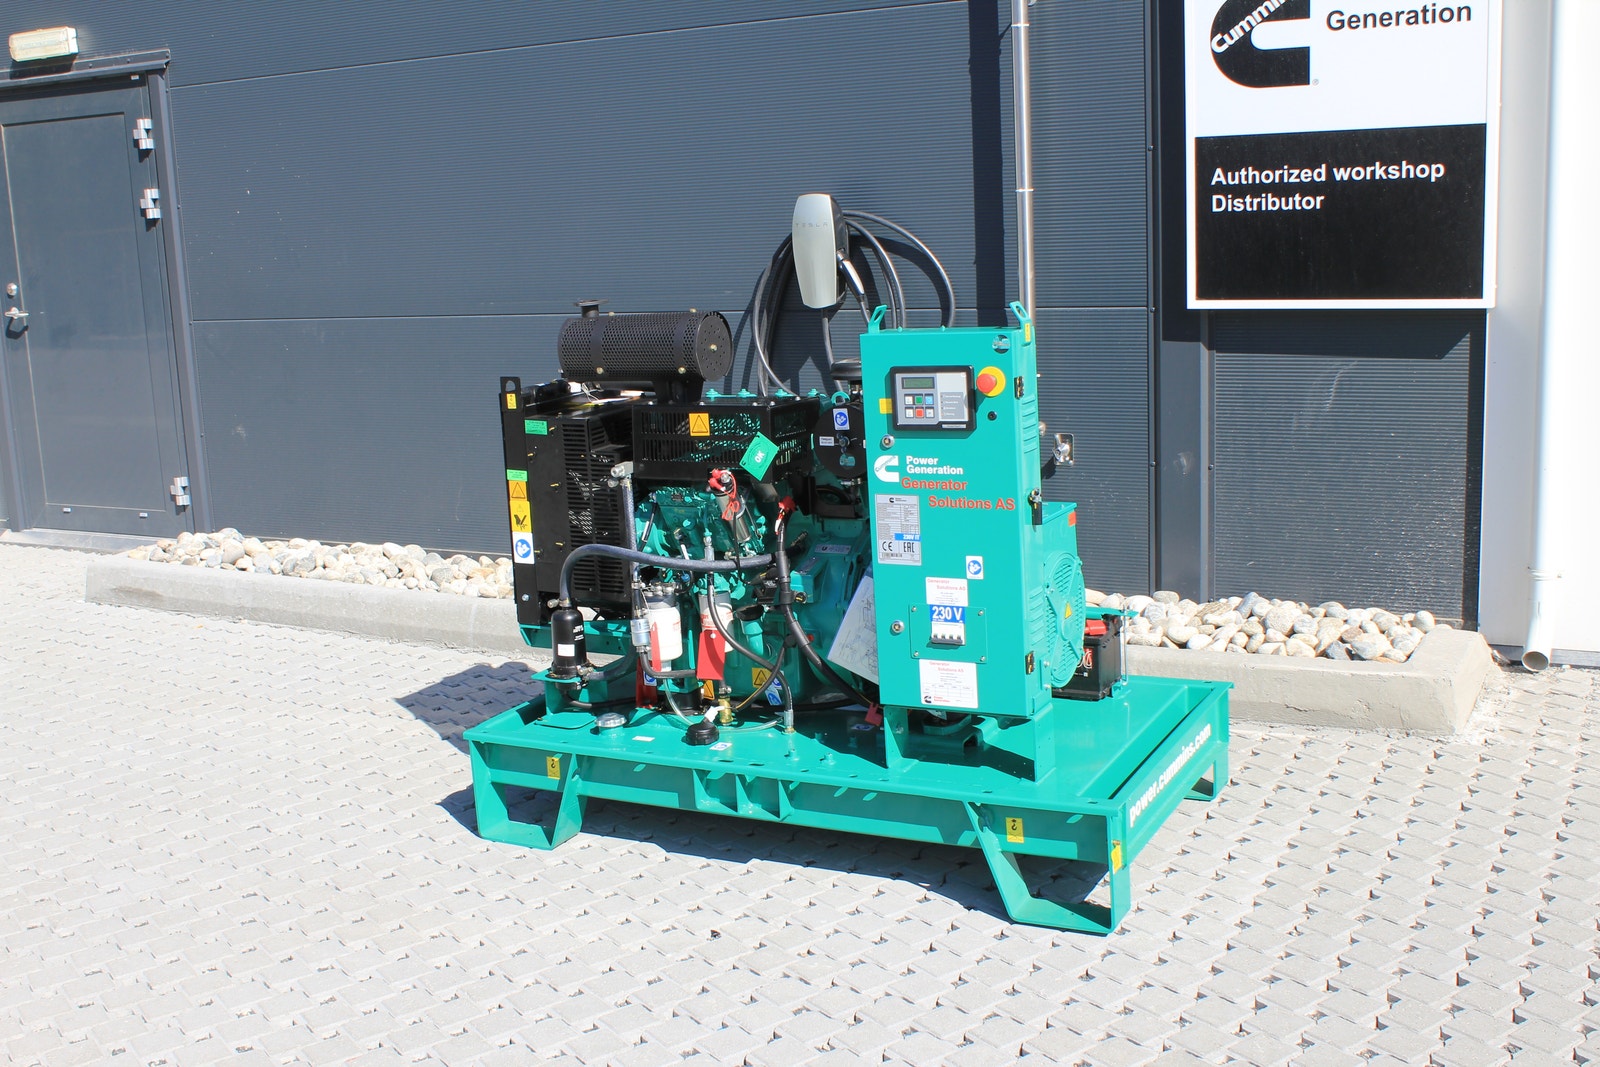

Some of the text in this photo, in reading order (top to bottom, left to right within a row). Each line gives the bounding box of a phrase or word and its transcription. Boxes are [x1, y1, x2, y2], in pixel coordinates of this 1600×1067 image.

[1326, 4, 1472, 31] Generation
[1211, 0, 1286, 53] Cummi
[1210, 160, 1445, 186] Authorized workshop
[1211, 194, 1325, 213] Distributor
[906, 455, 939, 465] Power
[906, 464, 964, 475] Generation
[901, 477, 967, 491] Generator
[928, 496, 1016, 511] Solutions AS
[932, 605, 963, 621] 230 V
[1129, 723, 1211, 828] power.cummins.com
